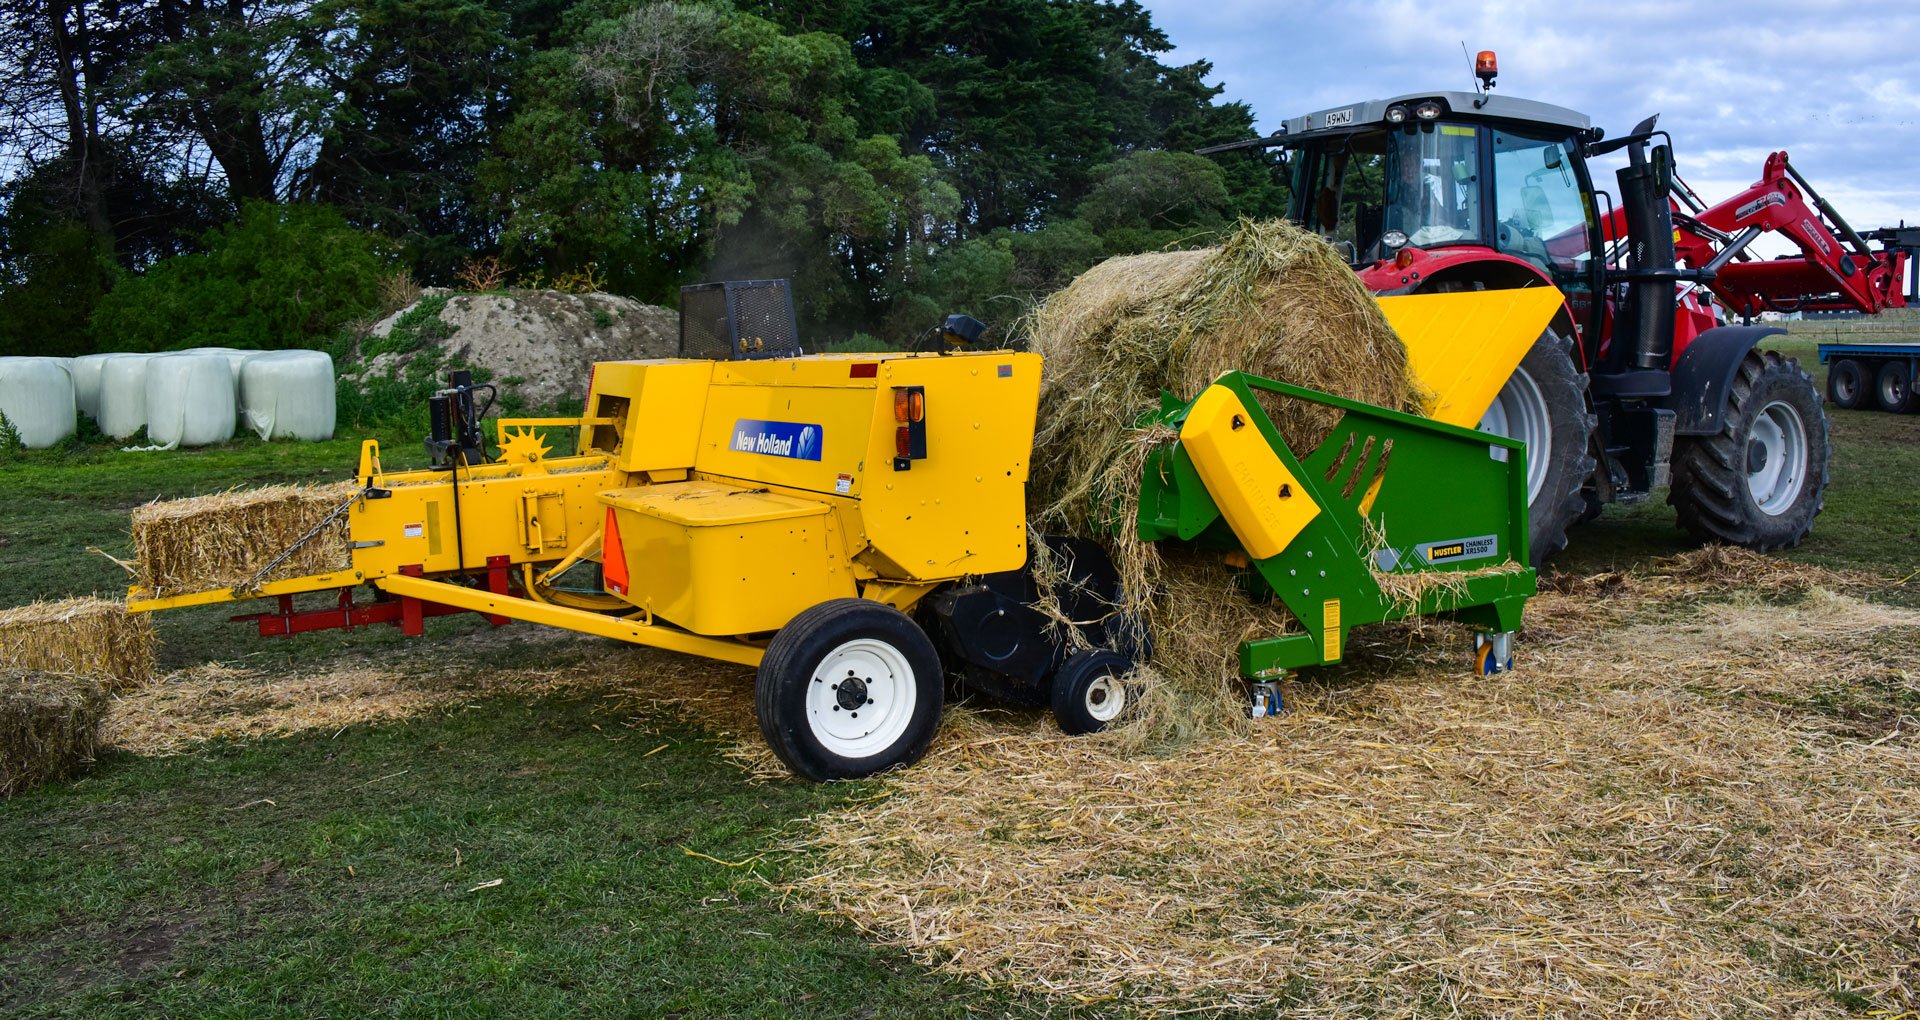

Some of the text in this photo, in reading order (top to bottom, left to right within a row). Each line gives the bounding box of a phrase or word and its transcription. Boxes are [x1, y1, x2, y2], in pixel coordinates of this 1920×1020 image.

[736, 431, 793, 456] New Holland
[1465, 539, 1493, 548] CHAINLESS
[1434, 546, 1462, 557] HUSTLER
[1466, 547, 1488, 555] XR1500
